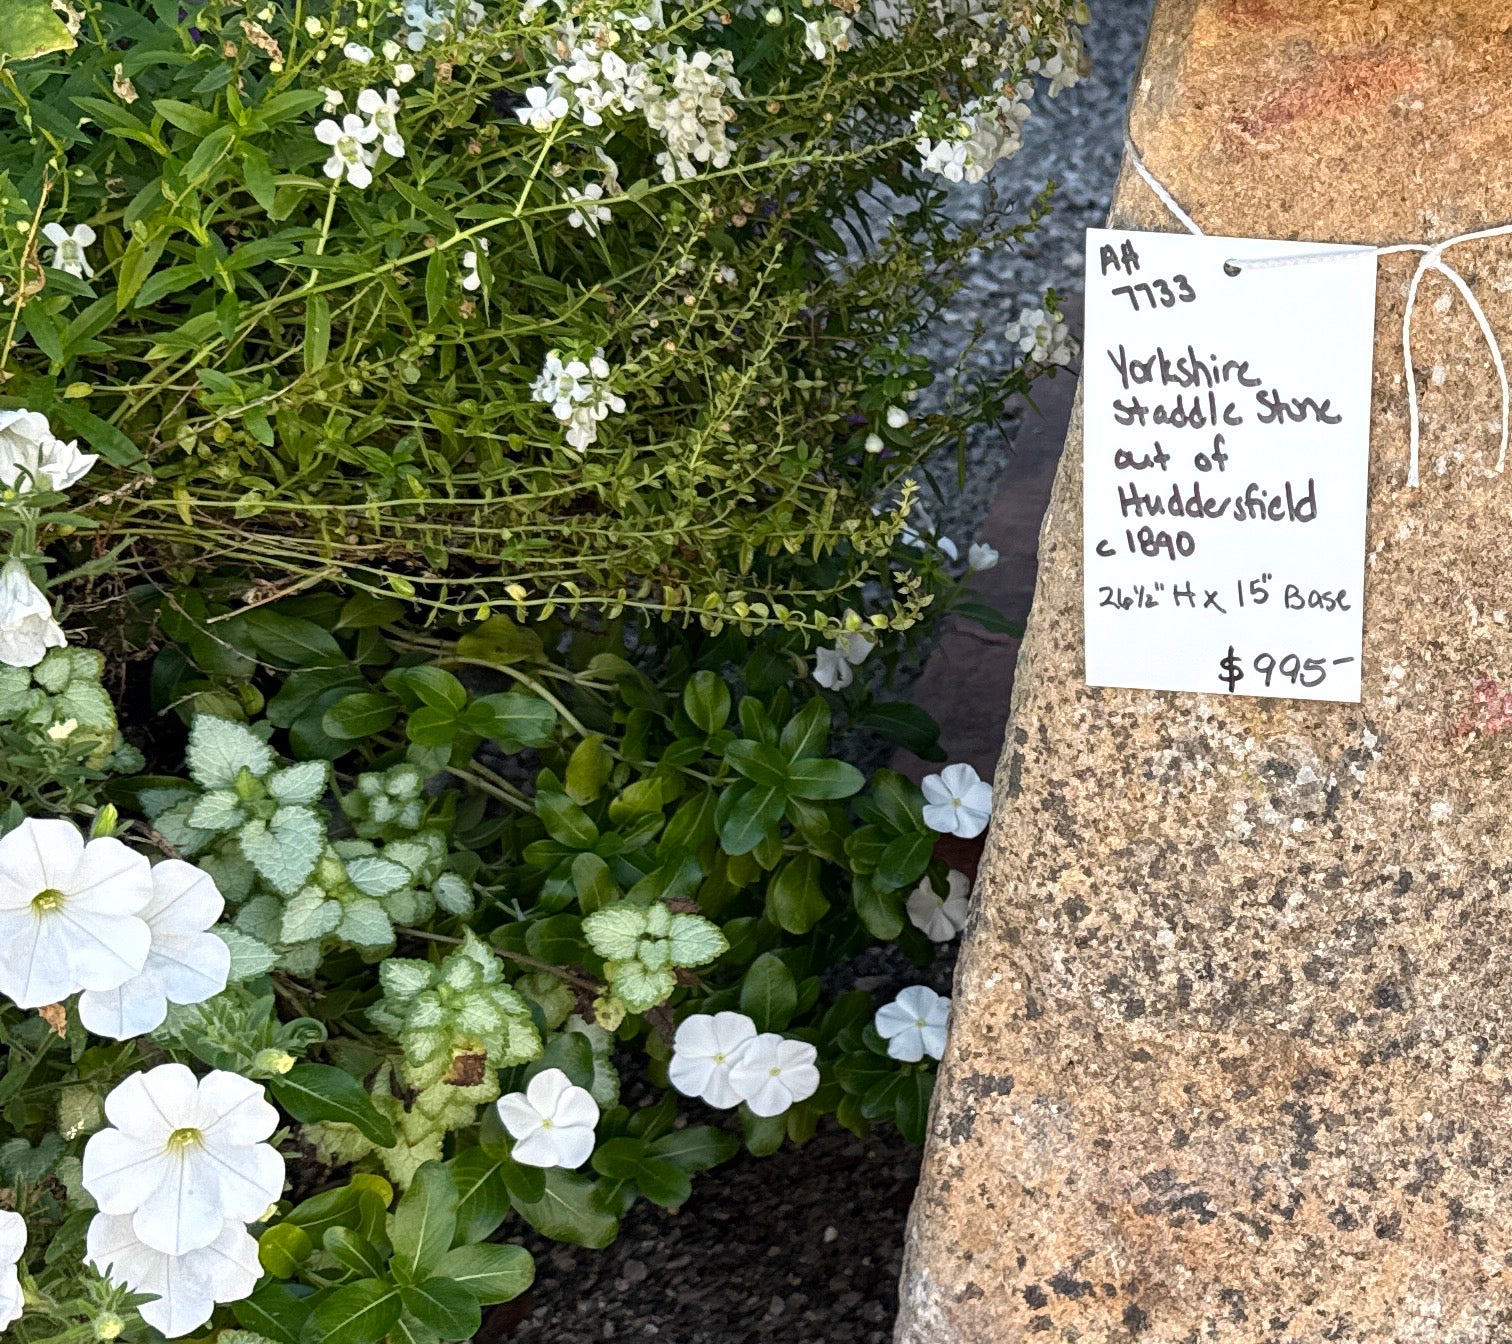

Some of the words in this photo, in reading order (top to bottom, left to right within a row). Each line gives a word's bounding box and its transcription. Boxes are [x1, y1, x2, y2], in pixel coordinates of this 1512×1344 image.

[1111, 272, 1196, 312] 7733
[1107, 344, 1263, 390] Yorkshire
[1114, 441, 1171, 472] out
[1194, 433, 1229, 473] of
[1117, 478, 1318, 523] Huddersfield
[1284, 584, 1351, 612] Base
